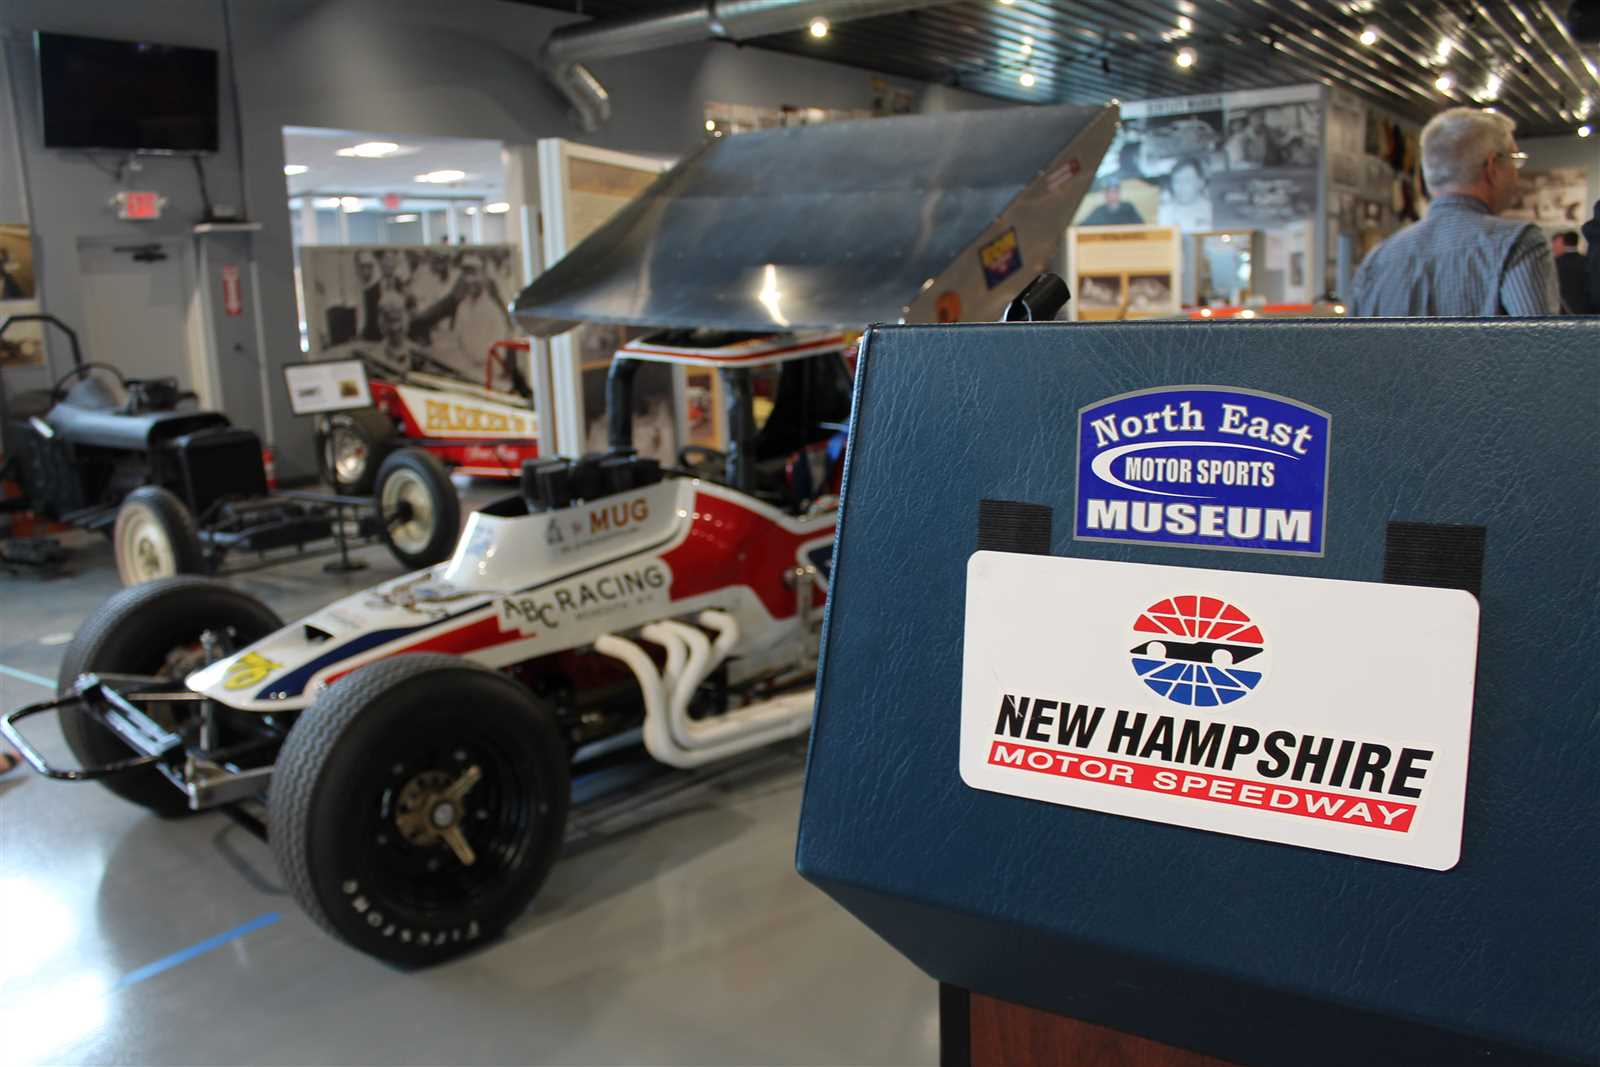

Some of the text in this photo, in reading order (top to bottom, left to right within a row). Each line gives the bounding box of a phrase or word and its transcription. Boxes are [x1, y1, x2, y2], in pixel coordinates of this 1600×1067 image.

[1090, 401, 1313, 455] North East
[1125, 457, 1275, 488] MOTOR SPORTS
[590, 498, 648, 534] MUG
[1086, 498, 1312, 544] MUSEUM
[502, 597, 560, 629] ABC
[554, 565, 664, 611] RACING
[995, 694, 1434, 798] NEW HAMPSHIRE
[993, 744, 1410, 828] MOTOR SPEEDWAY
